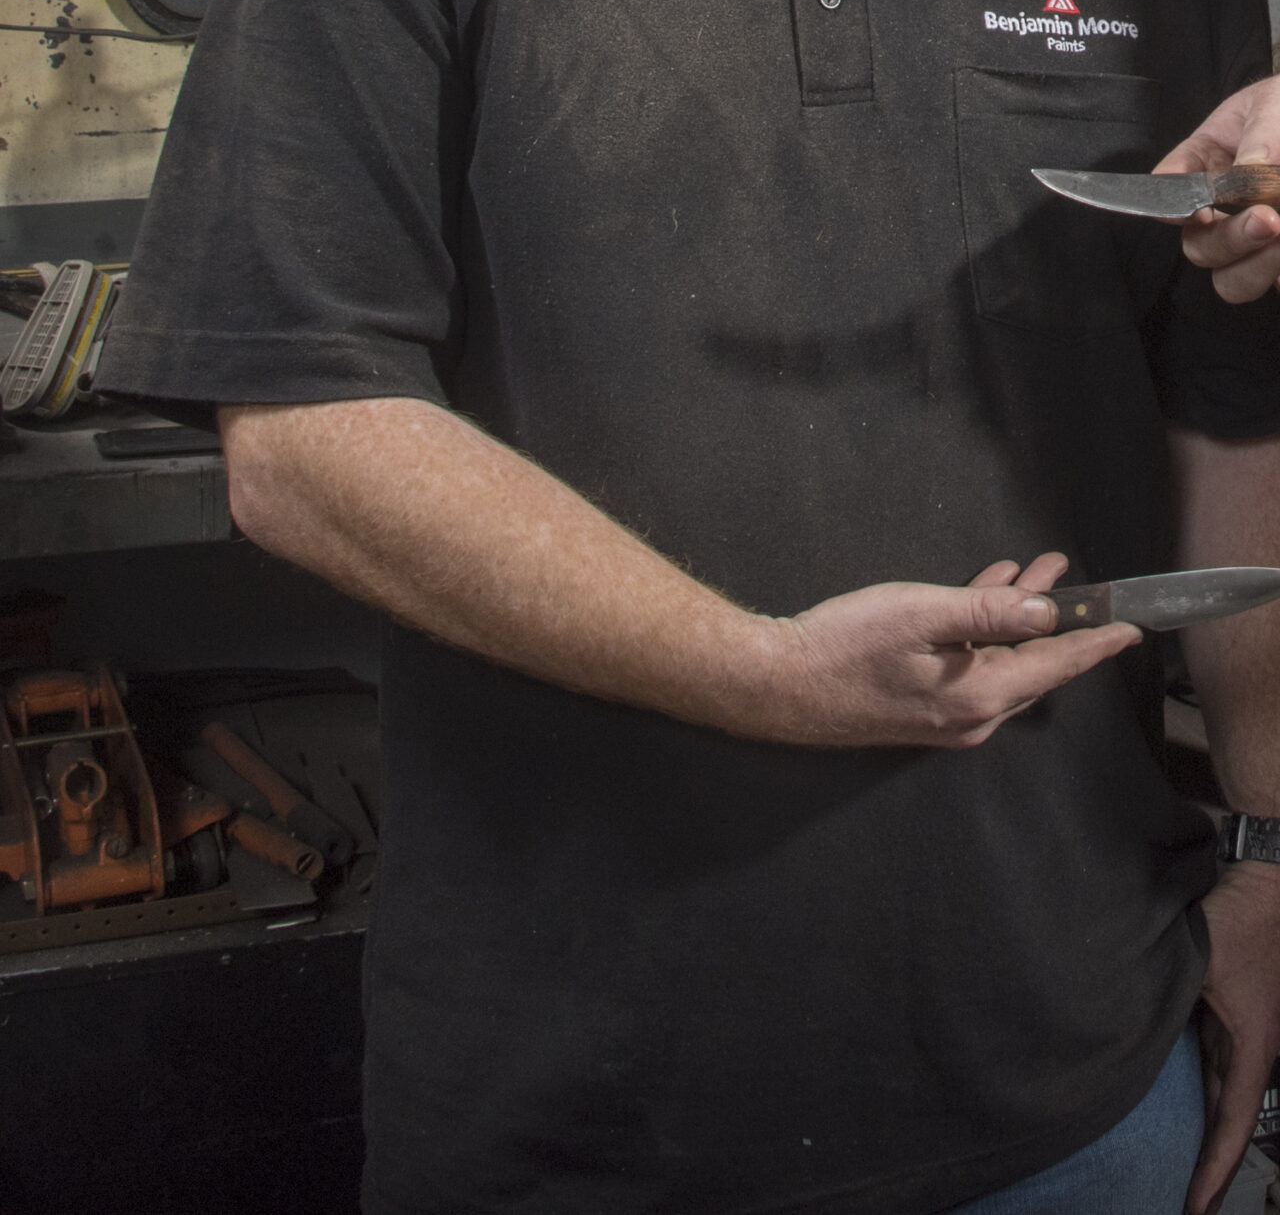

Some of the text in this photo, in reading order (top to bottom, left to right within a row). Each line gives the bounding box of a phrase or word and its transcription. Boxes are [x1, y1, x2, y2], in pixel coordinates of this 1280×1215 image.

[984, 11, 1139, 38] Benjamin Moore
[1047, 37, 1086, 52] Paints
